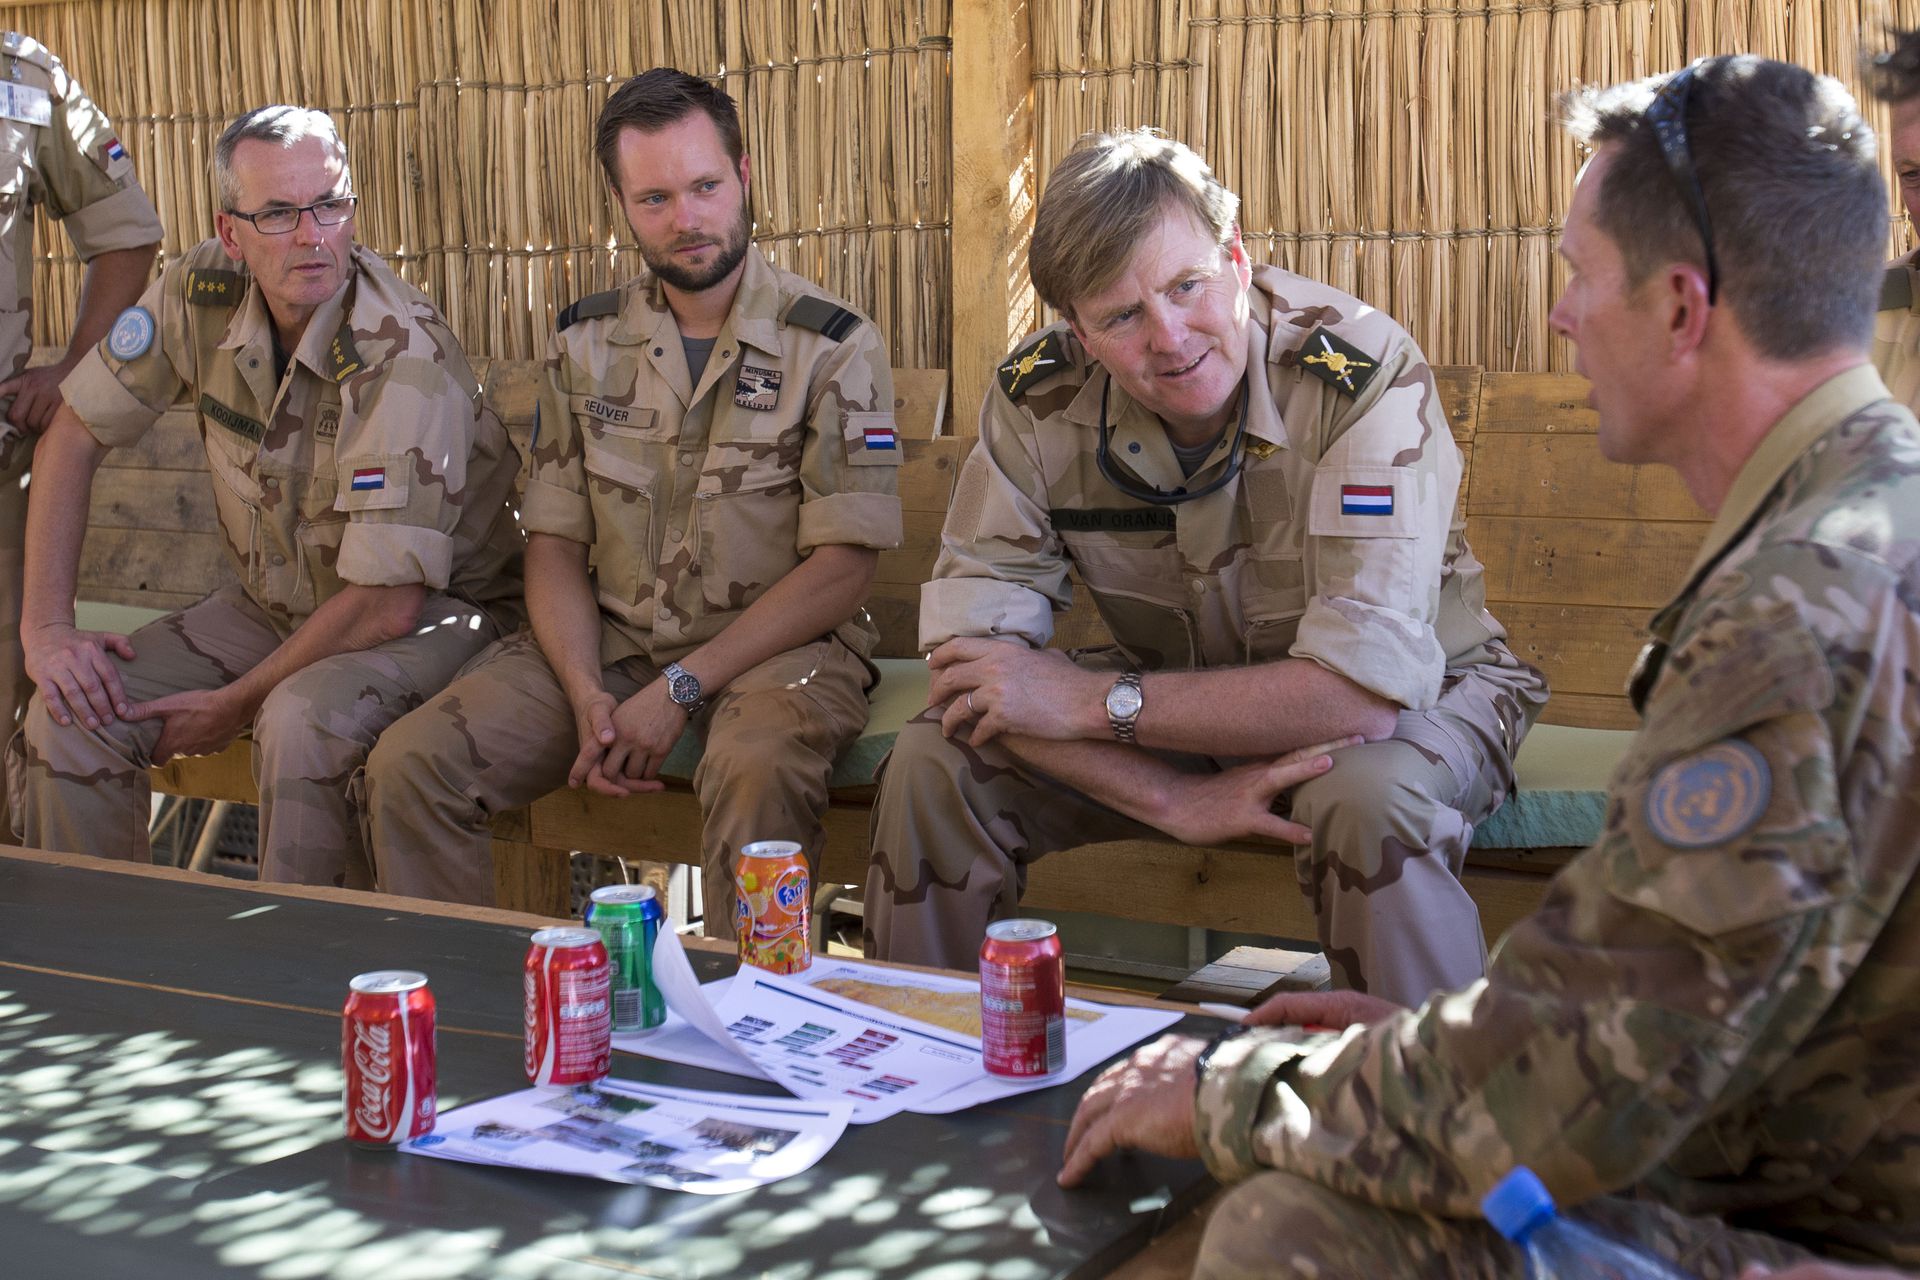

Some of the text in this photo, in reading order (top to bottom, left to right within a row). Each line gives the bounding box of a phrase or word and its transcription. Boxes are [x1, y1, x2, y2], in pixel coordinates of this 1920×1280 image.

[745, 366, 777, 378] MINUSMA
[583, 398, 630, 423] REUVER
[736, 398, 775, 410] HELIDET
[1070, 511, 1102, 528] VAN
[778, 877, 809, 907] Fanta
